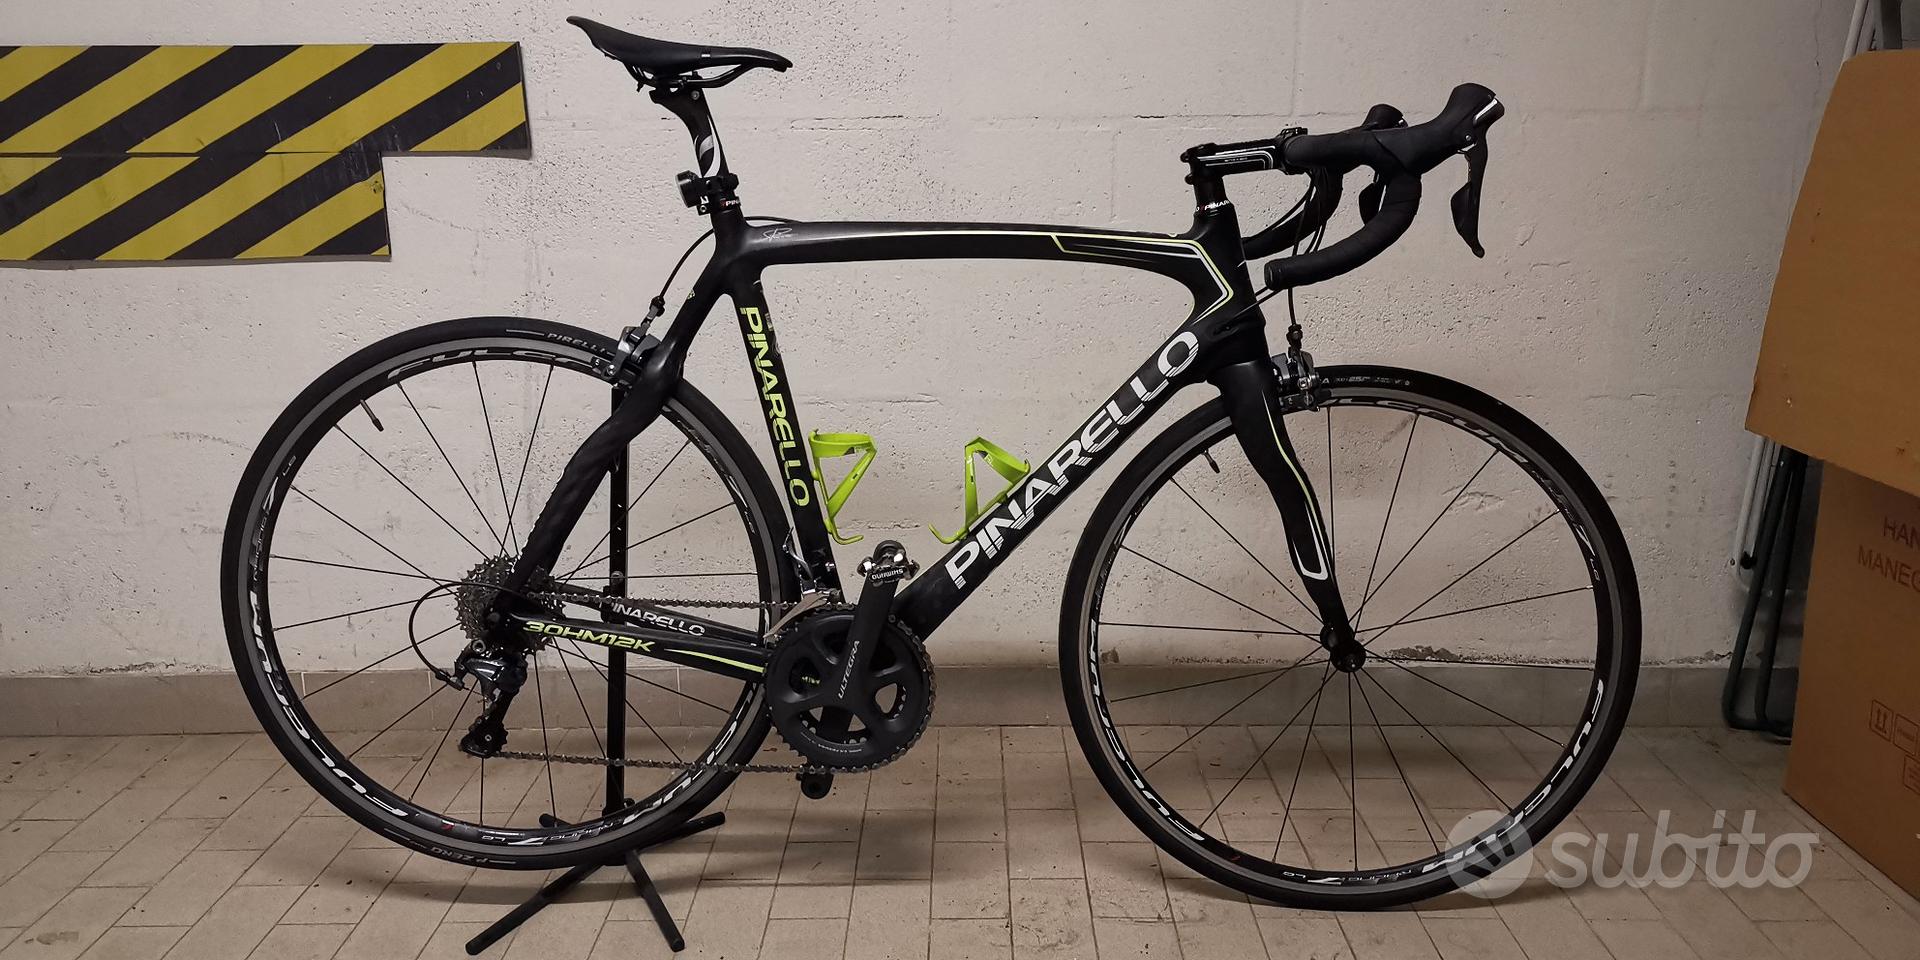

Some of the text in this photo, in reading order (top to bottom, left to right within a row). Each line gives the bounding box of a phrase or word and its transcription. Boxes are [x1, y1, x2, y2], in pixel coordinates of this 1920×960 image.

[546, 333, 605, 353] PIRELLI
[740, 306, 810, 507] PINARELLO
[944, 331, 1199, 589] PINARELLO
[838, 640, 860, 699] ULTEGRA
